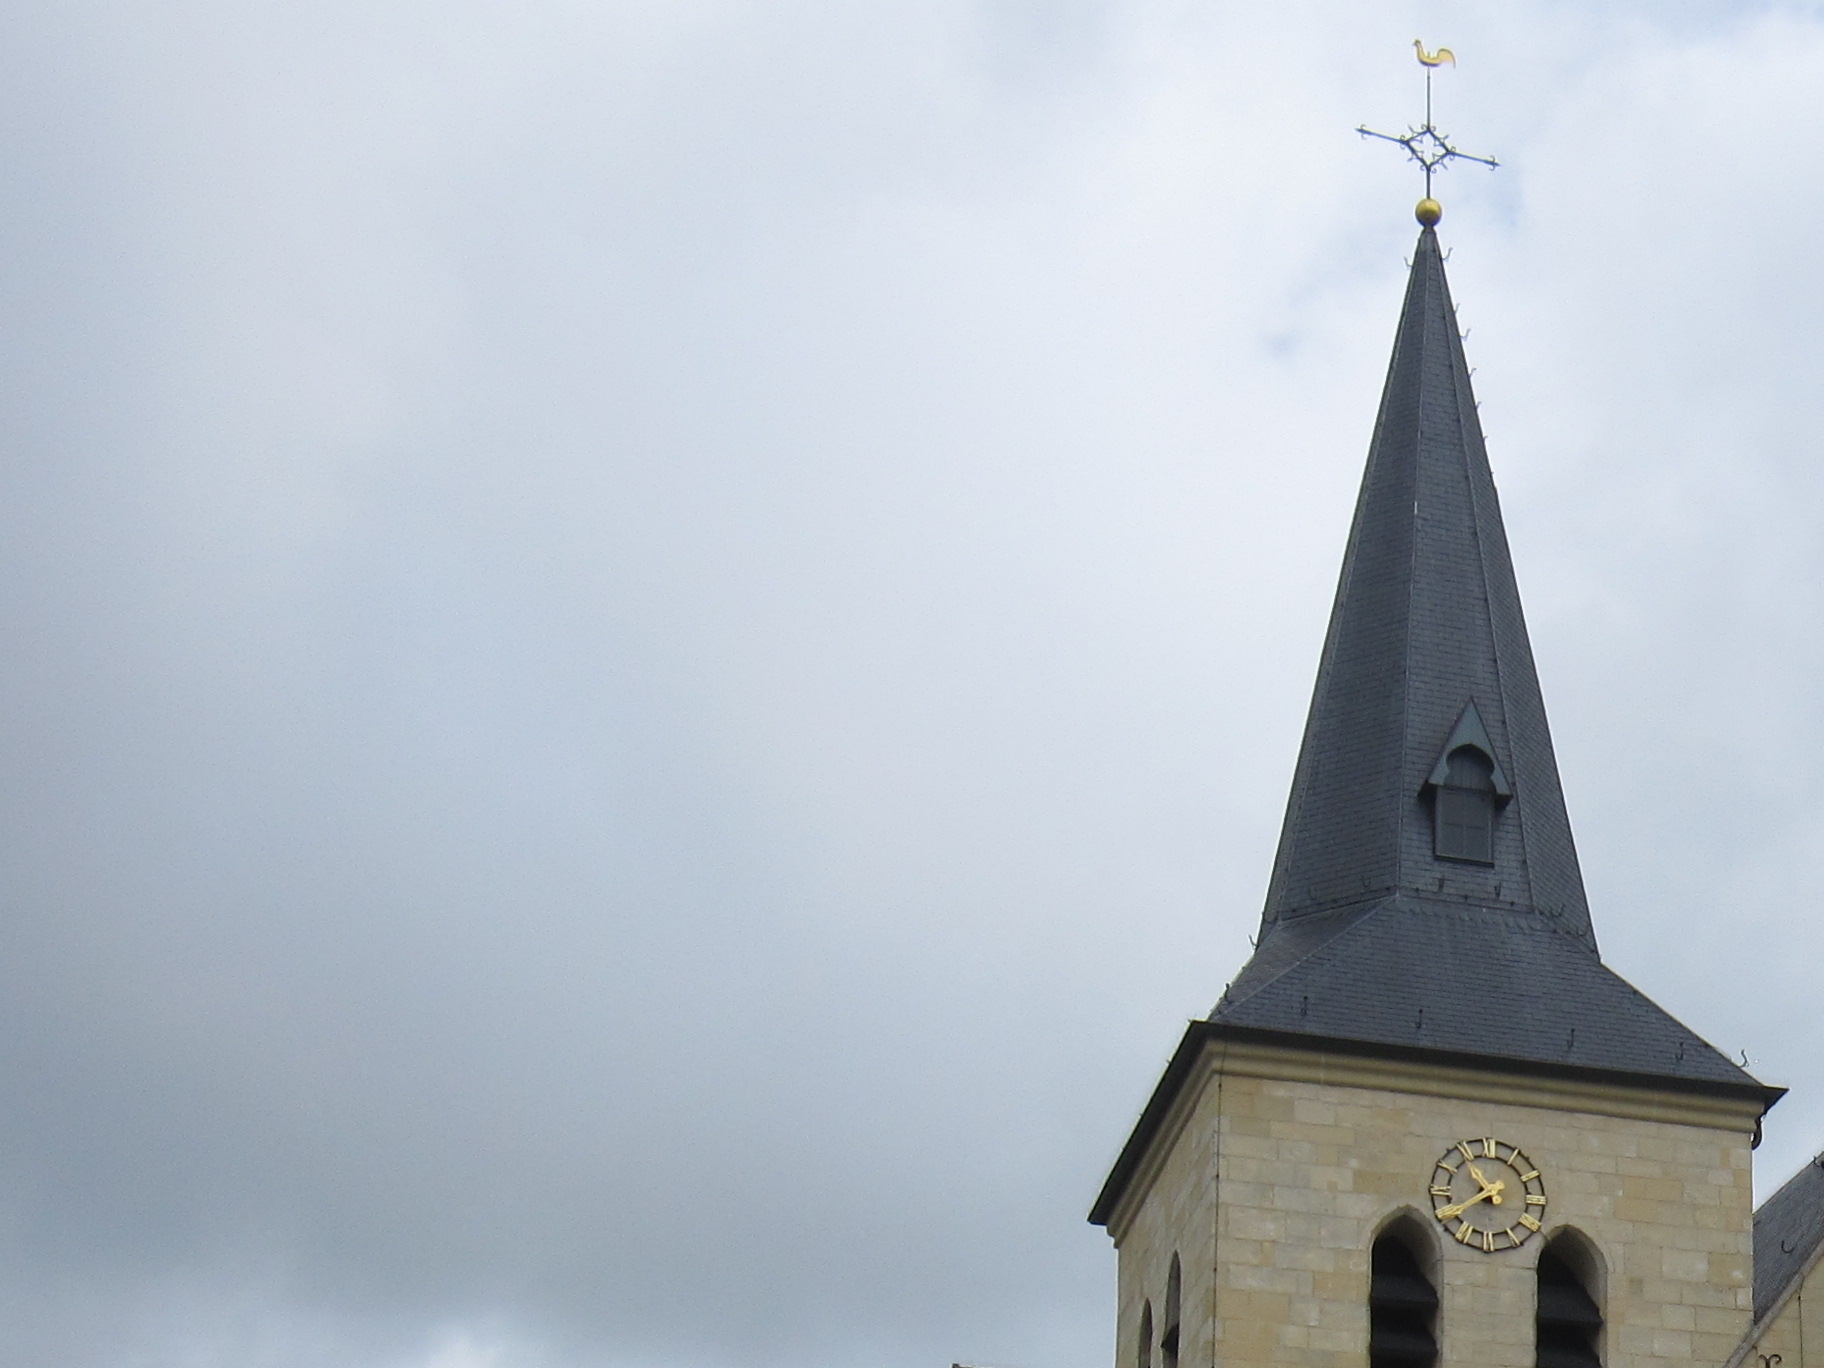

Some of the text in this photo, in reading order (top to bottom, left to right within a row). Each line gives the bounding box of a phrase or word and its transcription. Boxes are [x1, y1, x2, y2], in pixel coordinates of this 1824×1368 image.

[1508, 1148, 1520, 1166] I
[1520, 1169, 1540, 1182] II
[1525, 1194, 1547, 1205] III
